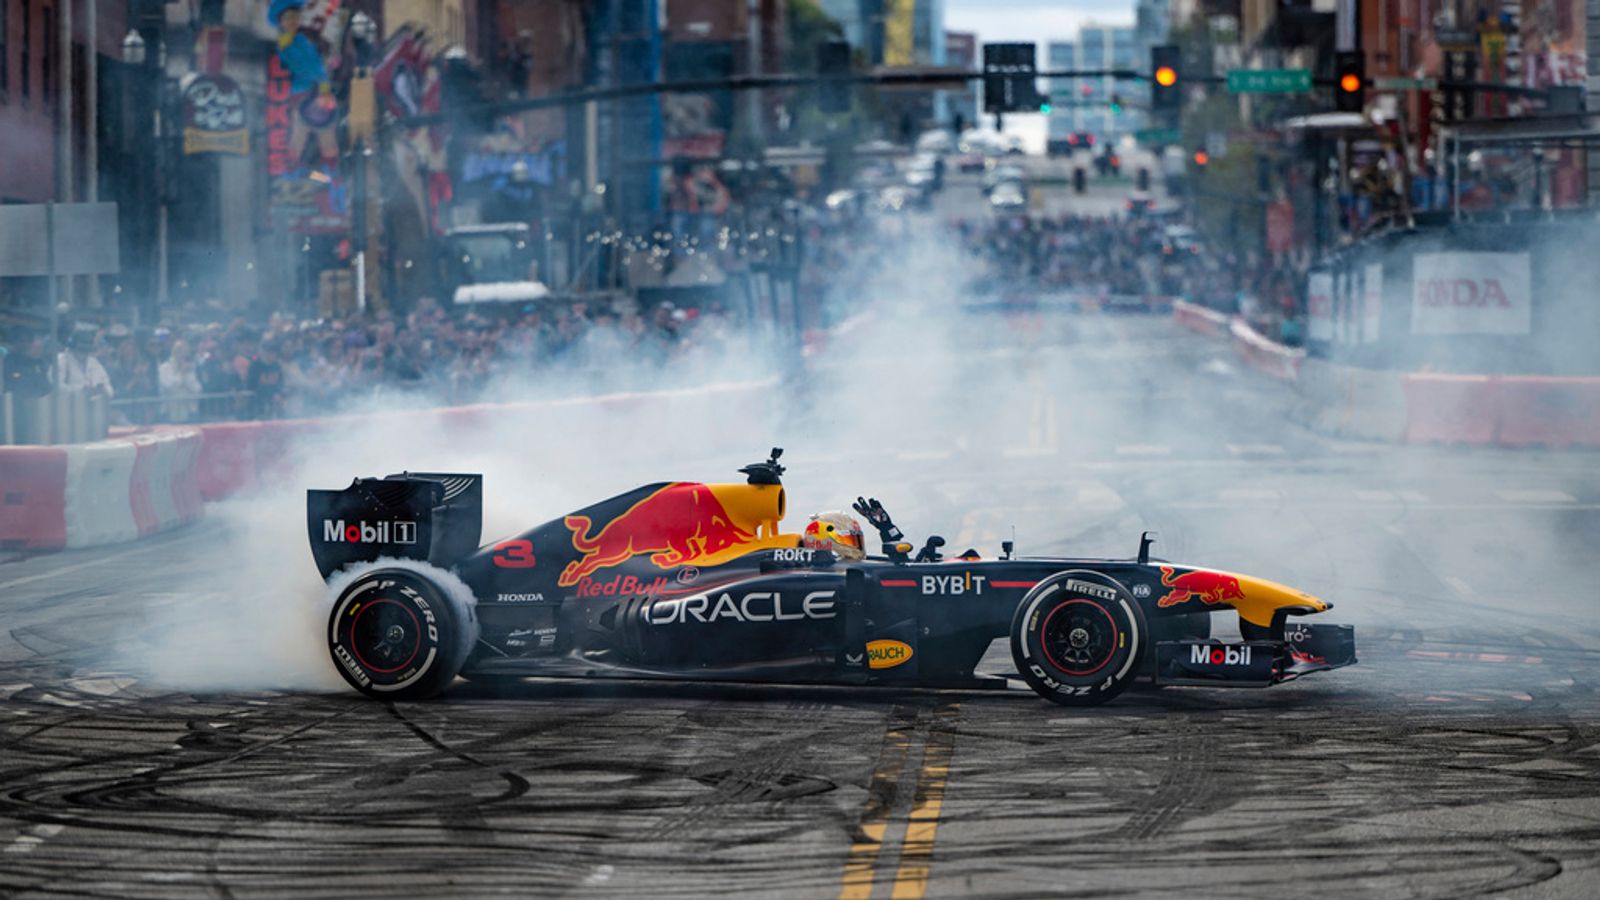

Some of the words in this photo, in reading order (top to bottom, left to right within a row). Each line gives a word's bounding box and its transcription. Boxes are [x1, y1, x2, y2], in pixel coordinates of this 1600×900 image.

[324, 519, 389, 544] Mobil
[494, 539, 536, 568] 3
[774, 548, 815, 562] ROKT
[922, 571, 985, 595] BYBIT
[1066, 578, 1117, 601] PIRELLI
[497, 593, 544, 601] HONDA
[640, 590, 838, 625] ORACLE
[400, 585, 439, 642] ZERO
[868, 646, 905, 660] RAUCH
[1190, 644, 1252, 665] Mobil
[1030, 664, 1092, 696] ZERO
